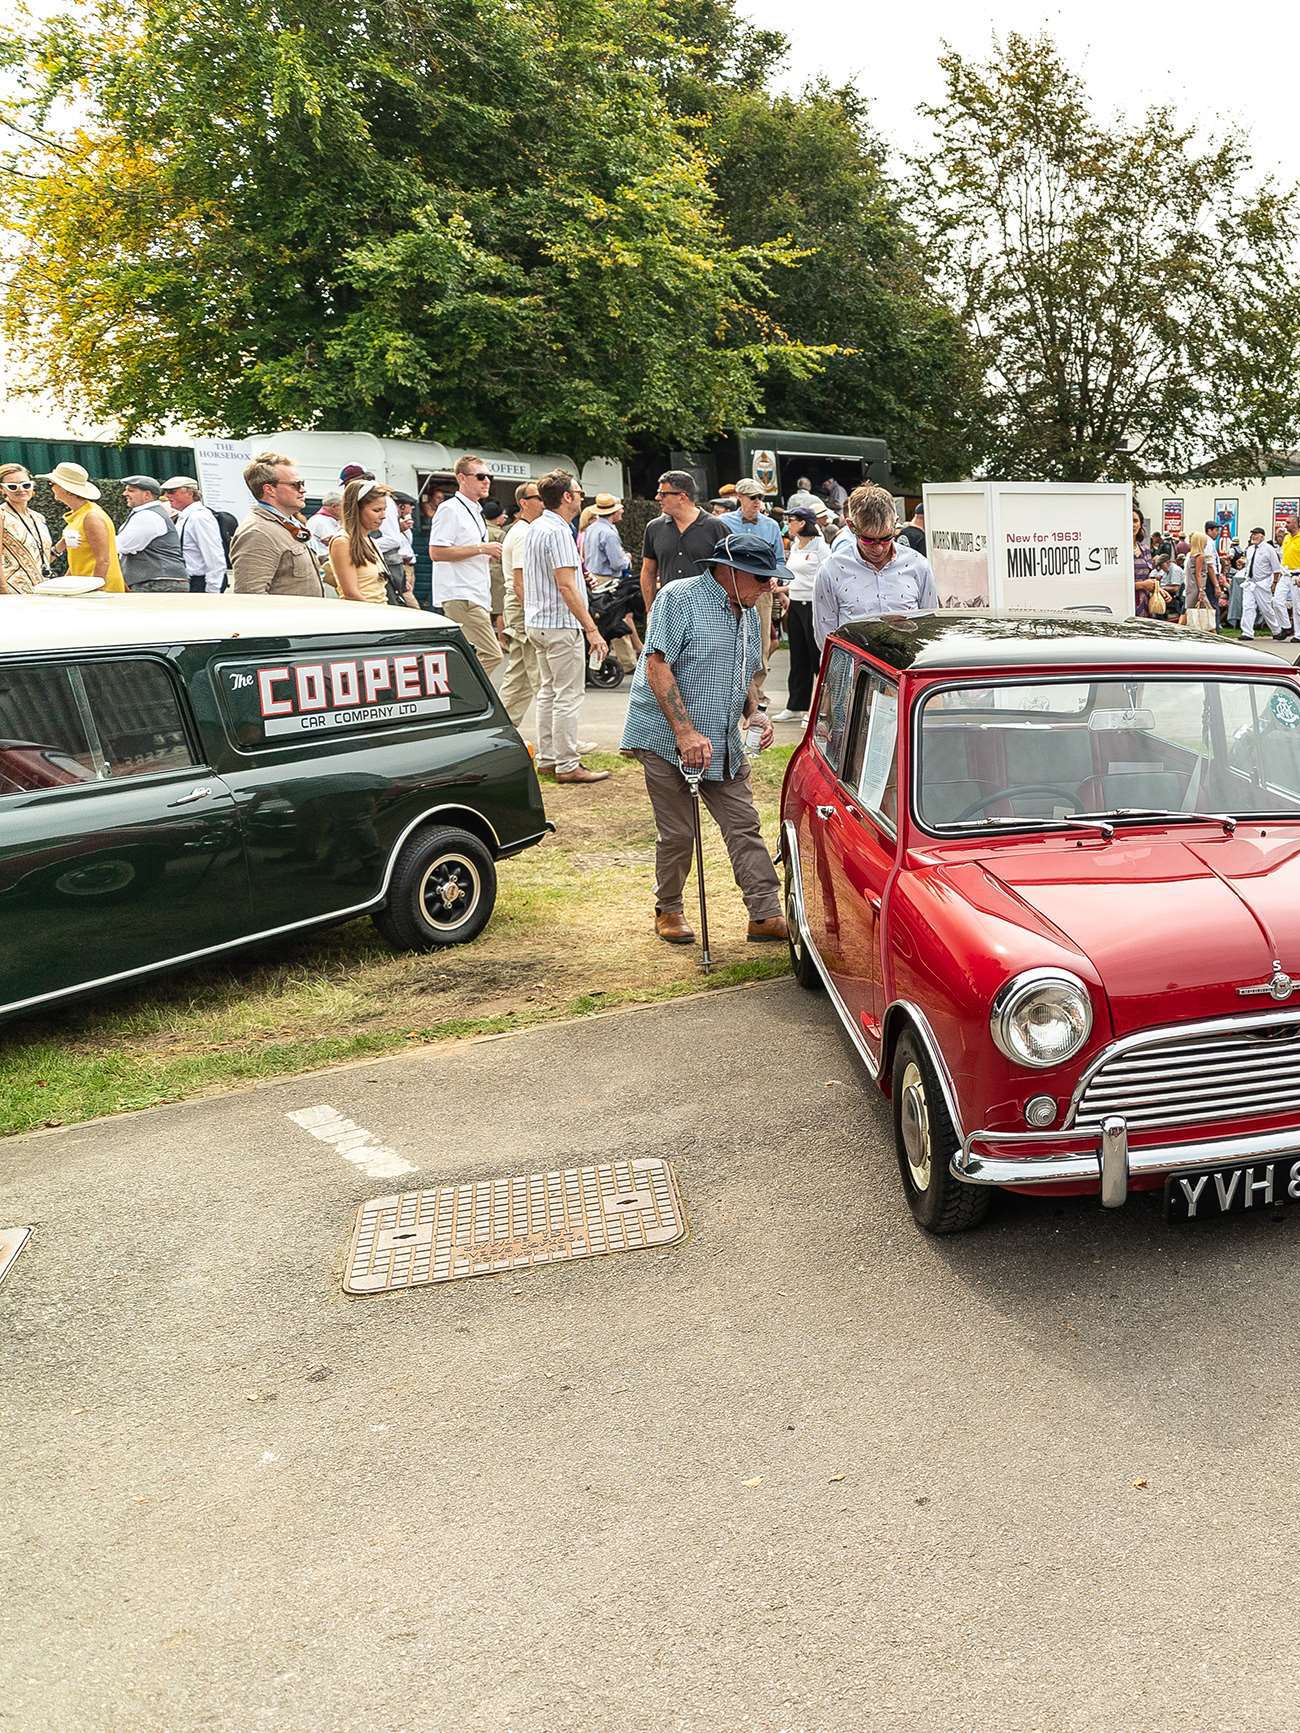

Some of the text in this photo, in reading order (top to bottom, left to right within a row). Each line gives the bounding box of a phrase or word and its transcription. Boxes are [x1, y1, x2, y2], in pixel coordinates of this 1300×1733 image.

[200, 451, 251, 460] HORSEBOX
[489, 463, 526, 475] OFFEE
[1006, 531, 1082, 543] New for 1963!
[1007, 546, 1081, 578] MINI-COOPER
[1104, 547, 1119, 565] TYPE
[229, 673, 254, 691] The
[256, 652, 452, 716] COOPER
[301, 703, 418, 729] CAR COMPANY LTD
[1272, 960, 1281, 971] S
[1179, 1164, 1275, 1217] YVH
